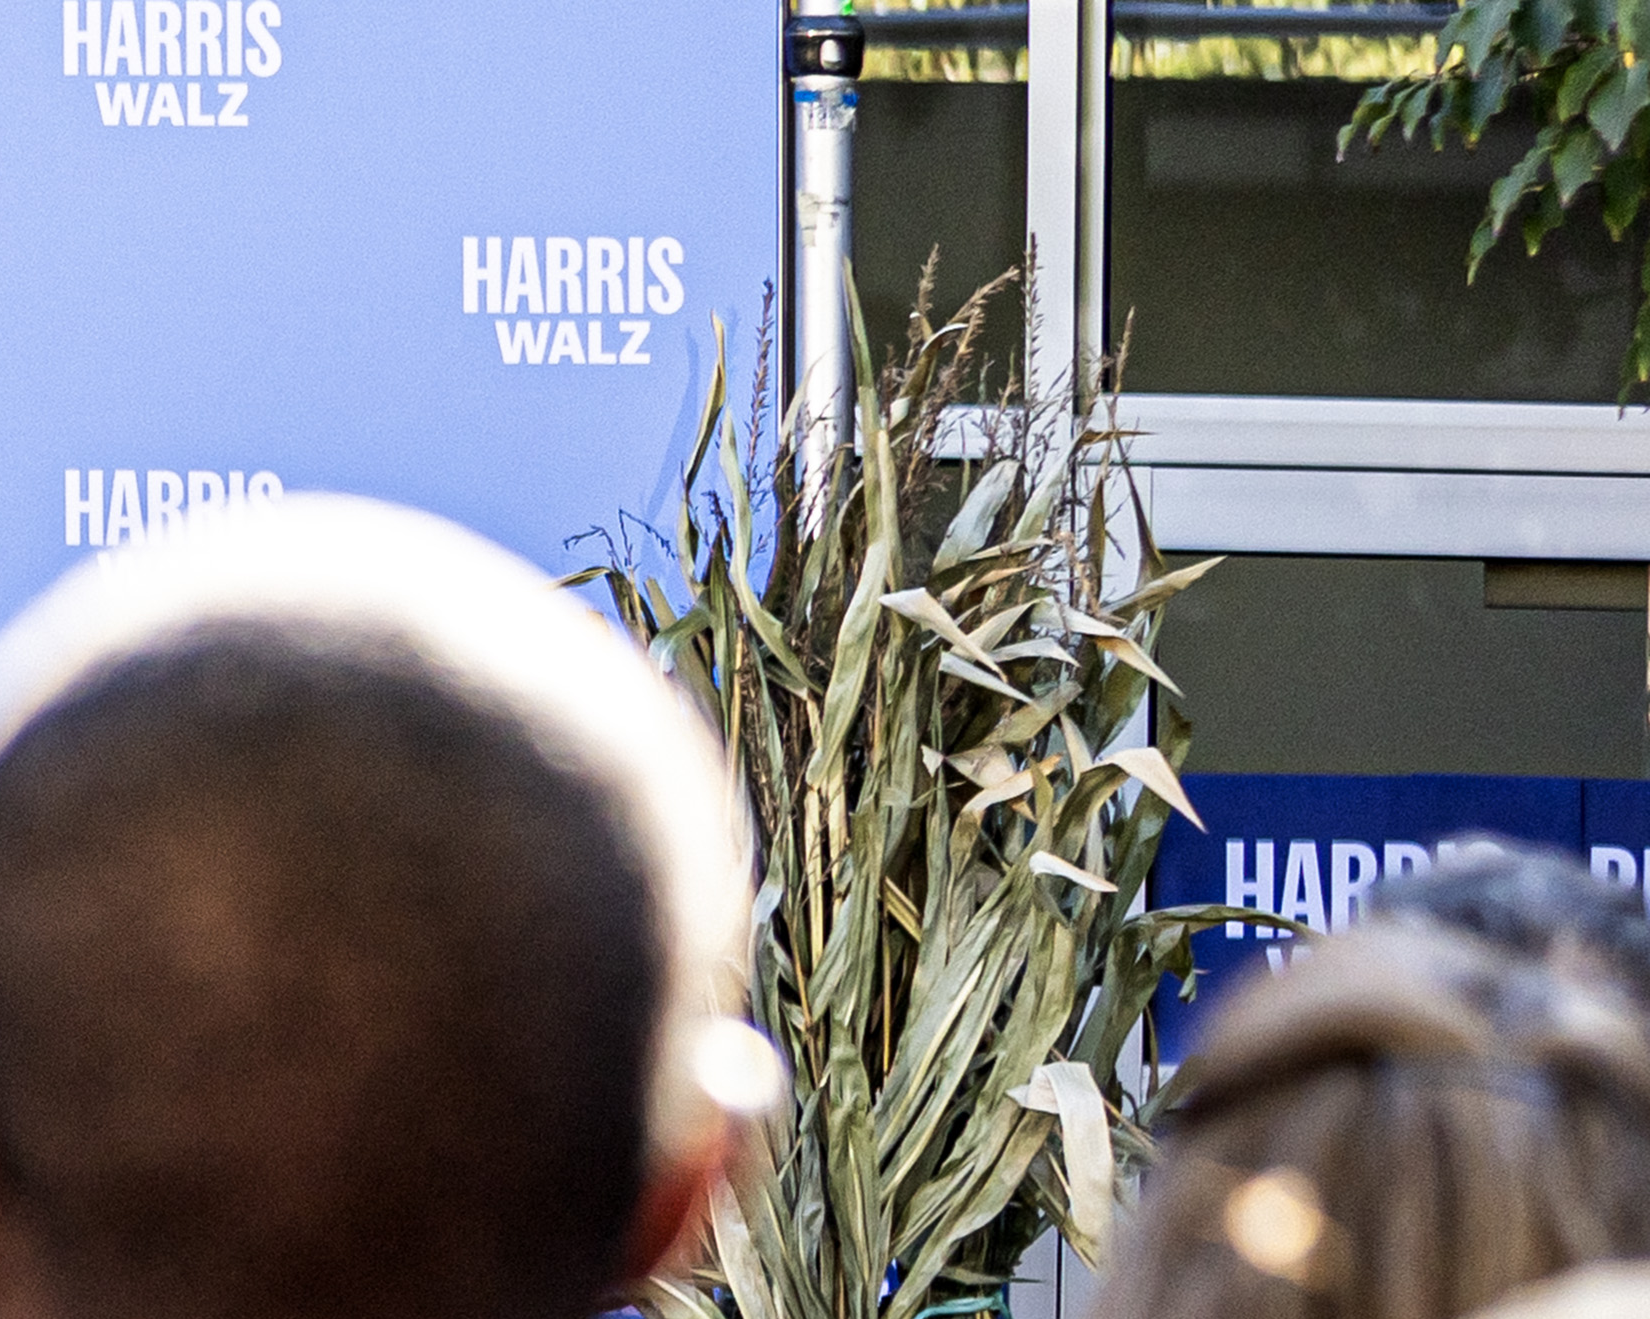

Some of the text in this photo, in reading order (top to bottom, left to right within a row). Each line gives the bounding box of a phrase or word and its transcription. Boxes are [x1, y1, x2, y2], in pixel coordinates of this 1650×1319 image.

[64, 0, 282, 77] HARRIS
[96, 83, 248, 126] WALZ
[463, 237, 683, 314] HARRIS
[496, 322, 650, 364] WALZ
